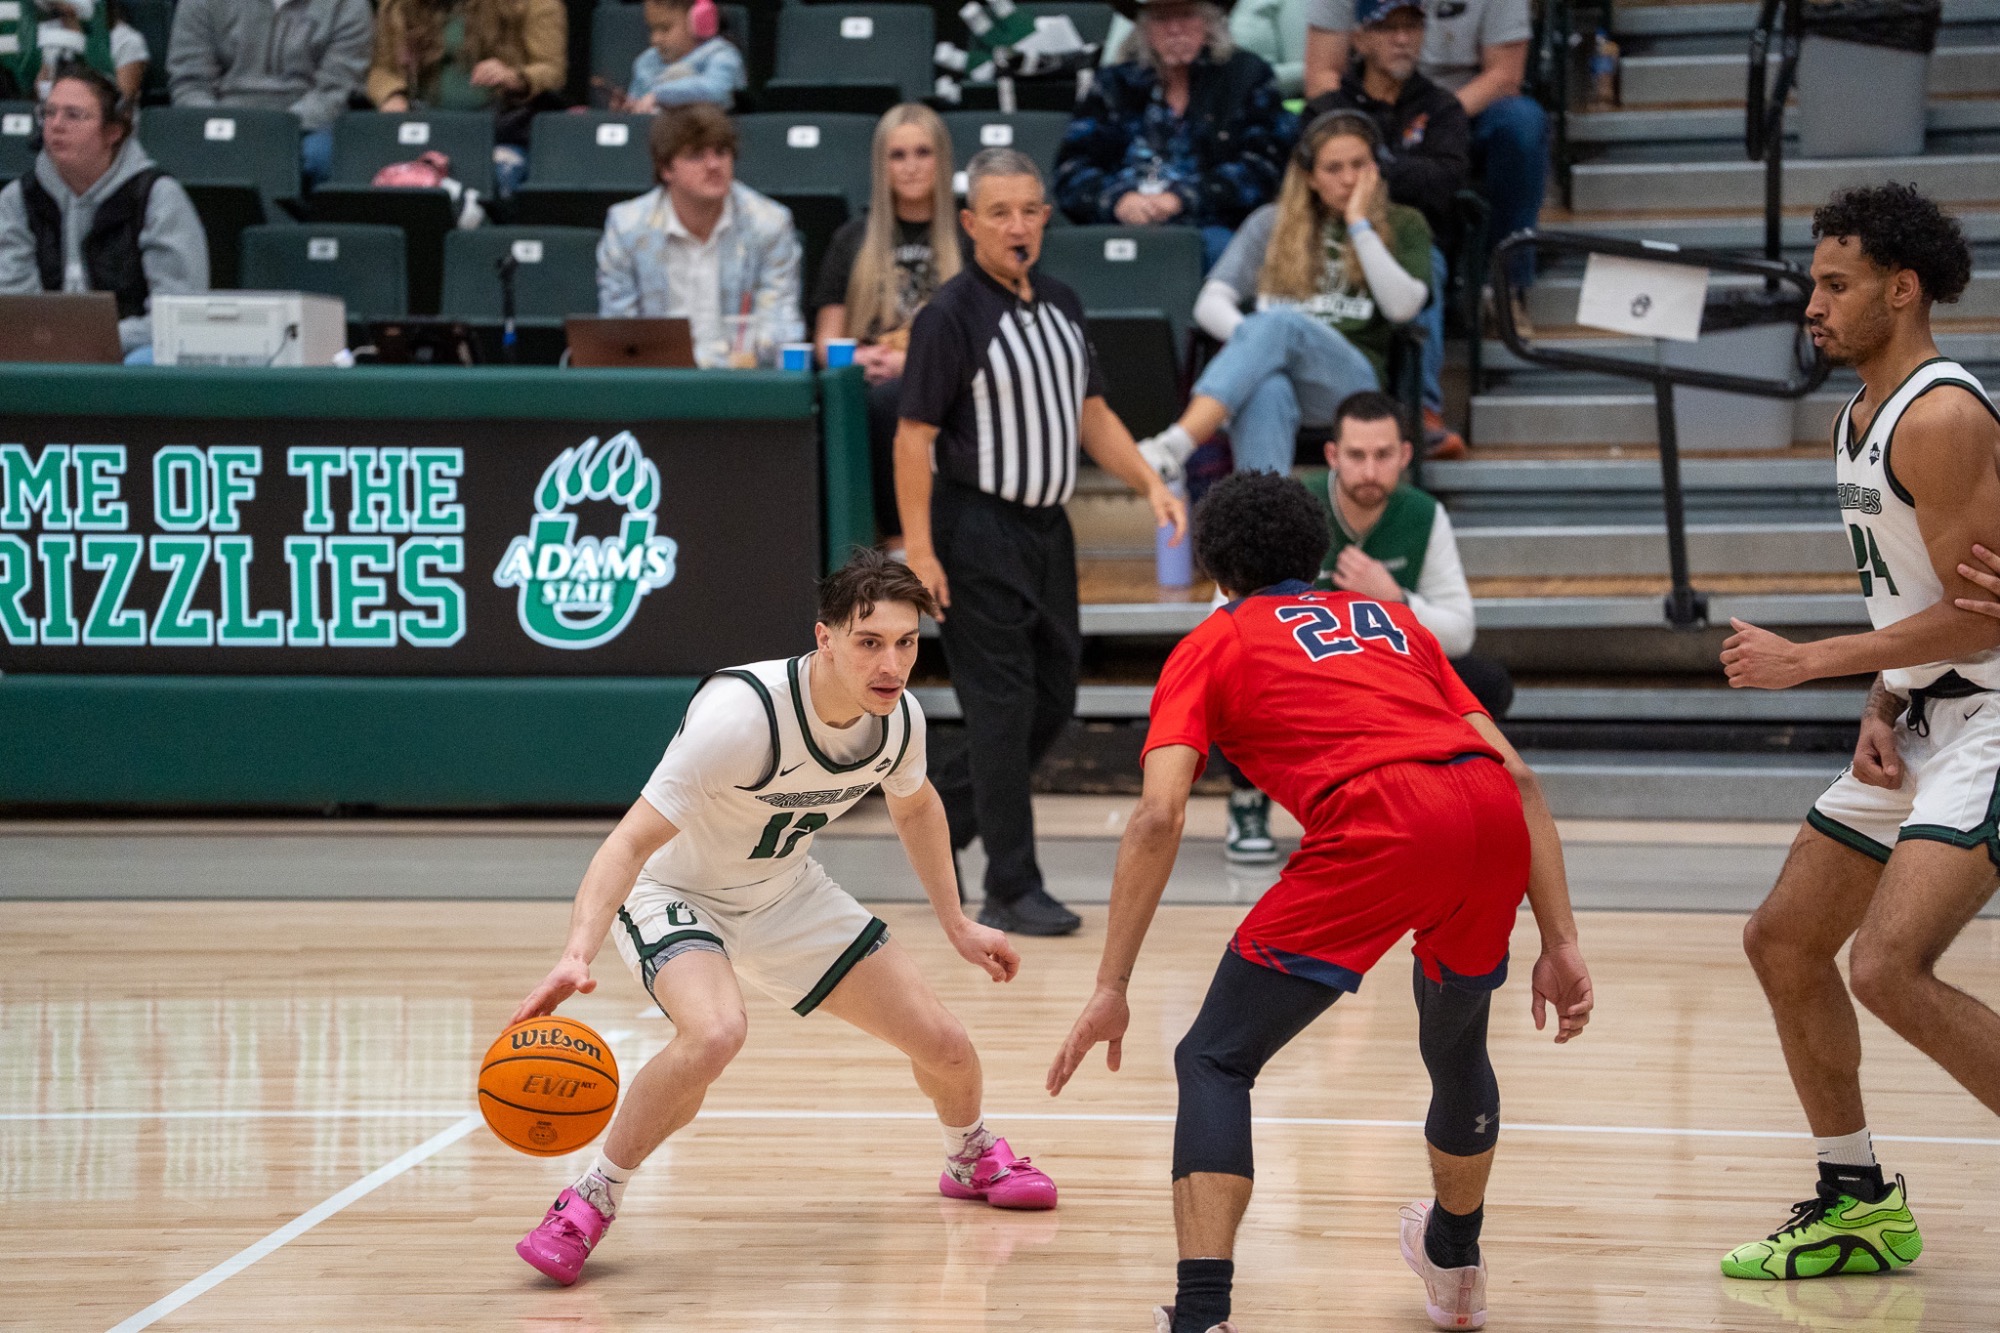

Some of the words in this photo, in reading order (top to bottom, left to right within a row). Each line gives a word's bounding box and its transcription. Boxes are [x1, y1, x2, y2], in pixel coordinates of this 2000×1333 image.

[153, 445, 262, 532] OF
[287, 446, 465, 533] THE
[500, 541, 669, 582] ADAMS
[541, 580, 617, 604] STATE
[1275, 601, 1411, 662] 24
[511, 1028, 603, 1062] Wilson
[522, 1073, 580, 1098] EVO
[580, 1081, 598, 1091] NXT
